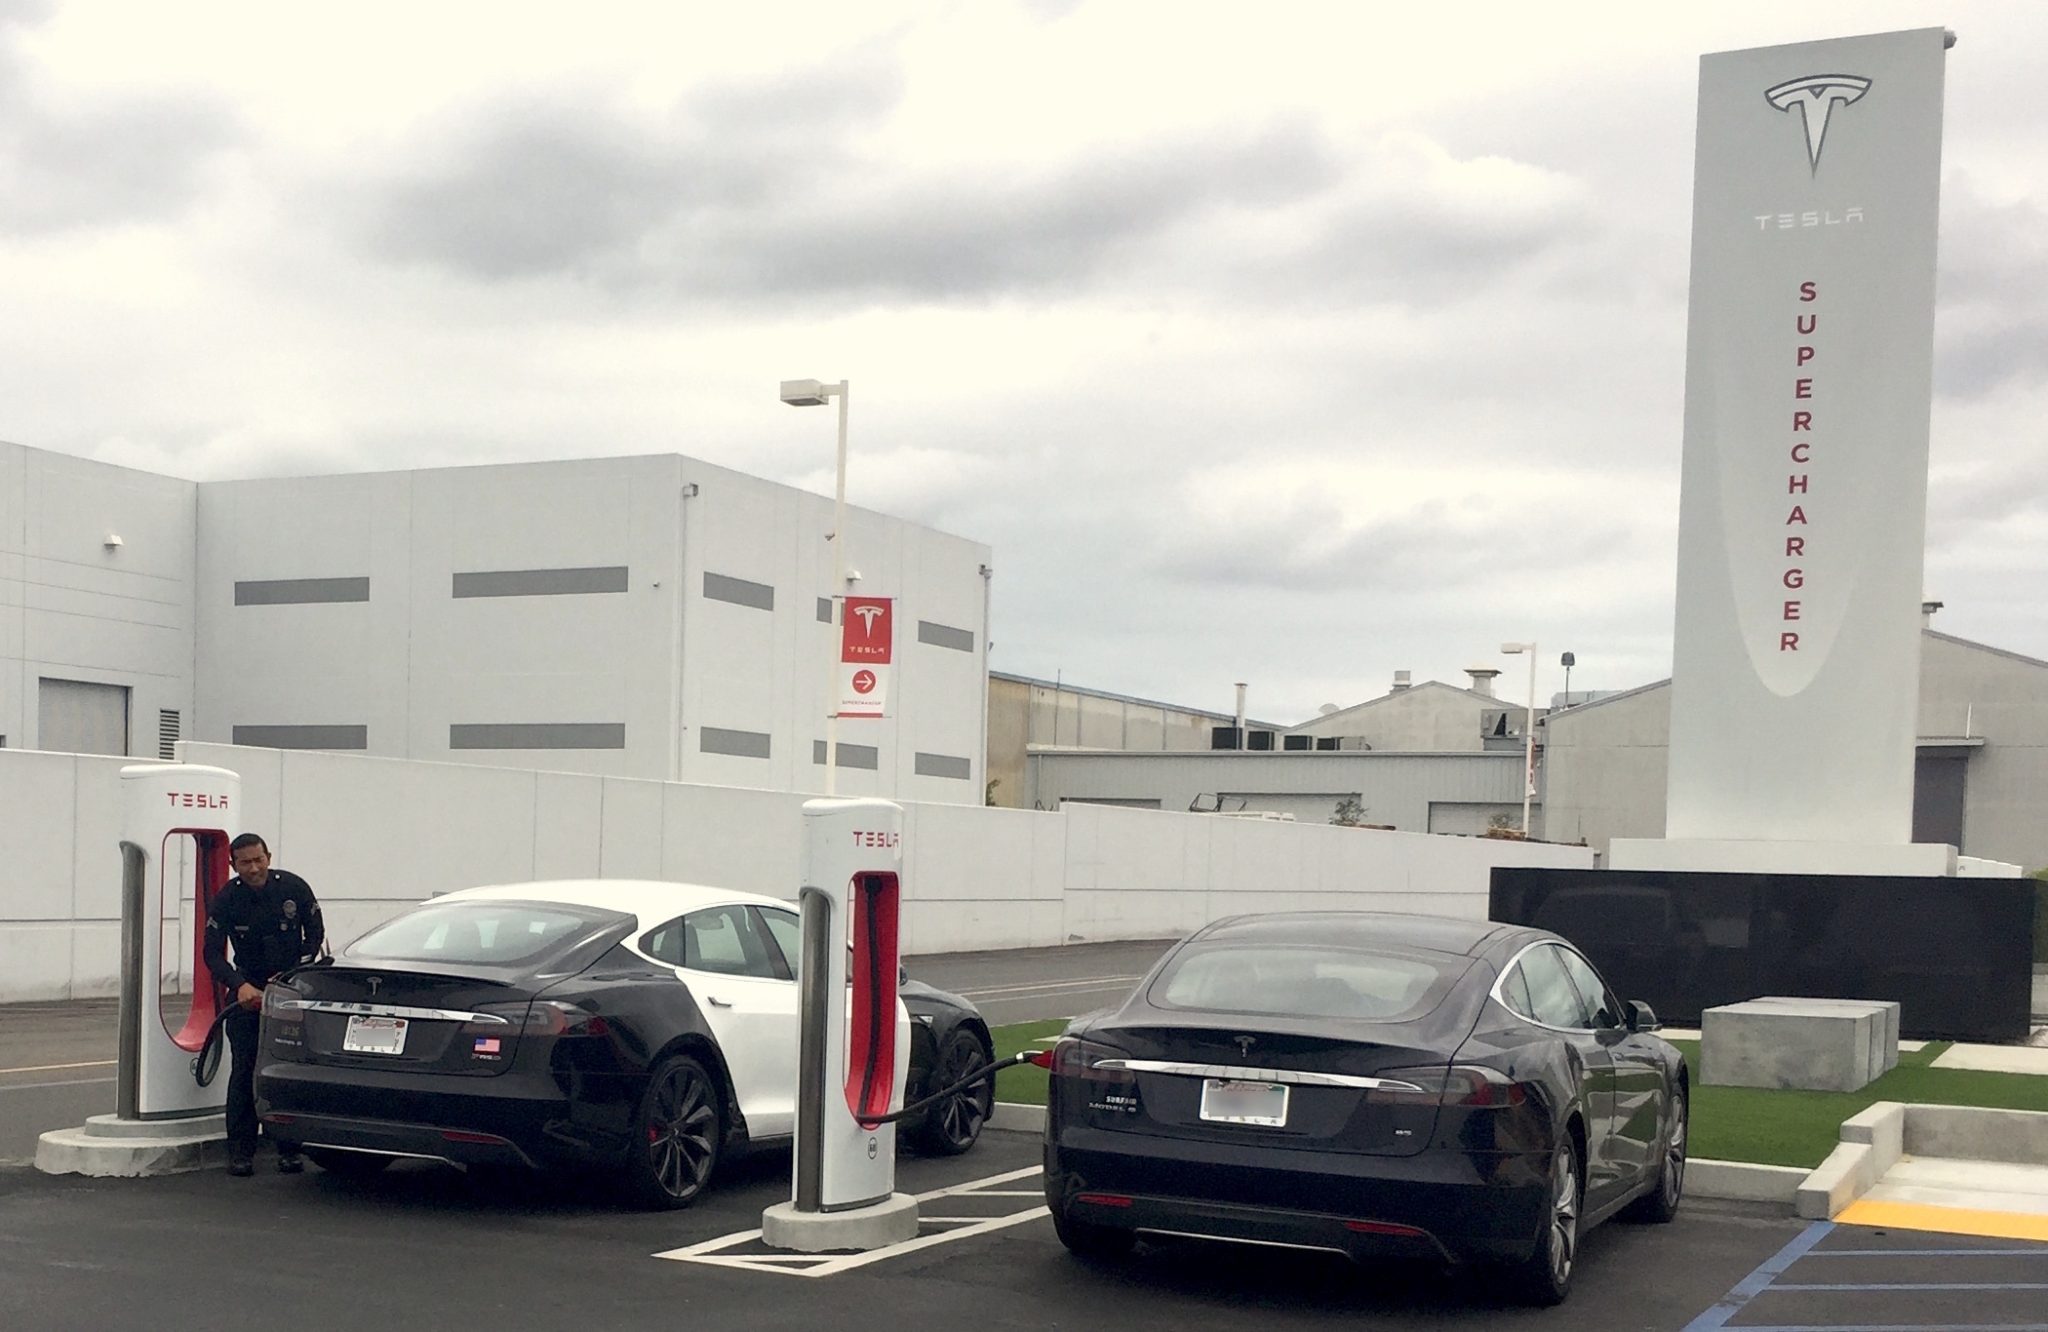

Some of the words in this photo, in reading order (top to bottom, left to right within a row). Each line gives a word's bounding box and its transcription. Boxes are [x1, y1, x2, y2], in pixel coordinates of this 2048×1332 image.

[1755, 207, 1864, 231] TESLA
[1779, 281, 1817, 652] SUPERCHARGER
[849, 646, 885, 655] TESLA
[167, 793, 228, 809] TESLA
[853, 831, 899, 848] TESLA
